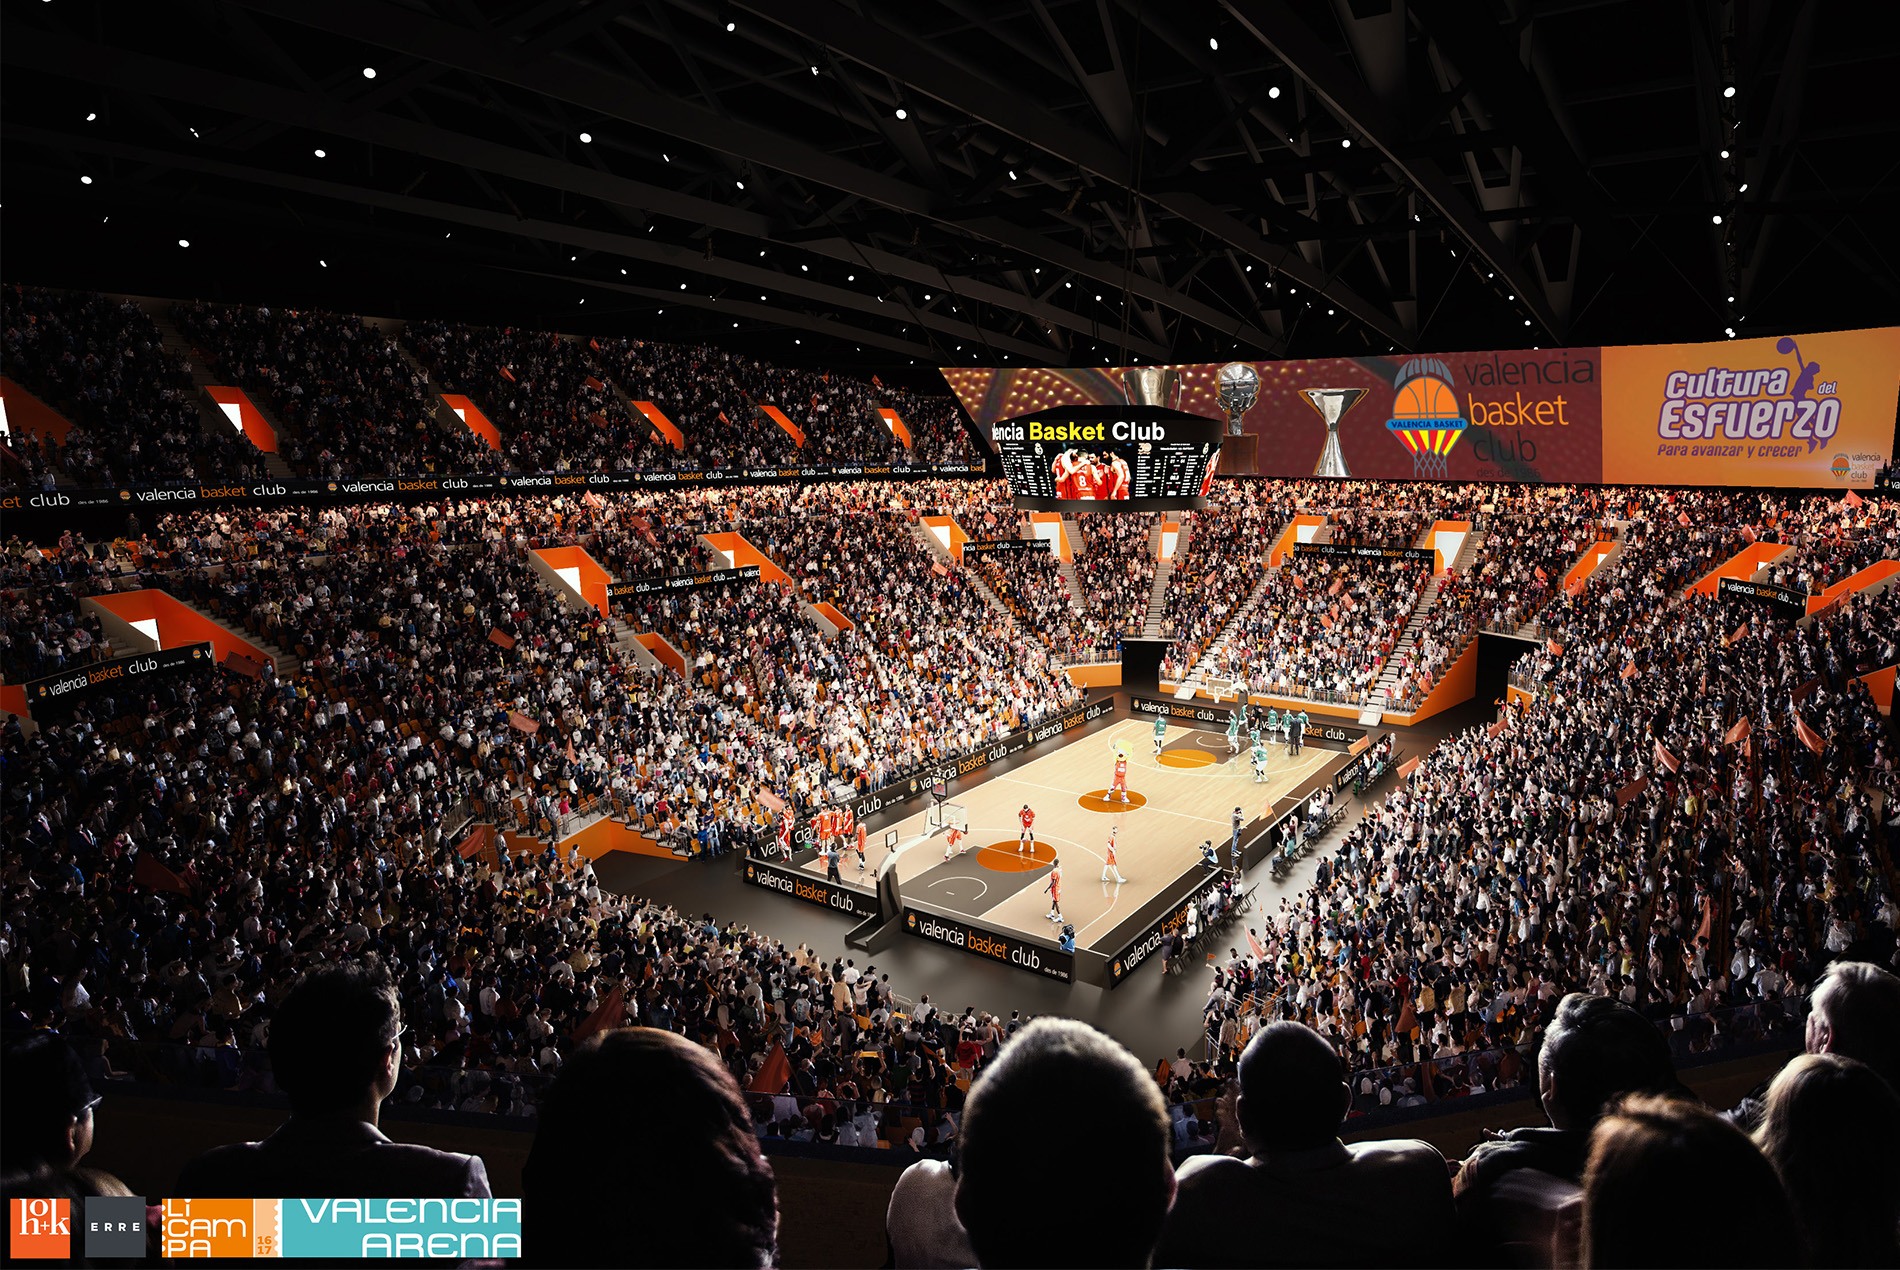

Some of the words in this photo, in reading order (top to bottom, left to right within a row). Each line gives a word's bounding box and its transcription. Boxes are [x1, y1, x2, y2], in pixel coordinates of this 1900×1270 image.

[1464, 352, 1594, 386] valencia
[1664, 367, 1791, 399] Cultura
[1817, 381, 1837, 395] del
[1468, 392, 1569, 426] basket
[1029, 421, 1105, 441] Basket
[1111, 421, 1165, 441] Club
[1391, 420, 1432, 429] VALENCIA
[1434, 420, 1463, 429] BASKET
[1473, 430, 1537, 462] club
[1657, 444, 1688, 456] Para
[1691, 445, 1743, 457] avanzar
[1748, 445, 1755, 458] y
[1758, 444, 1803, 457] crecer
[1851, 452, 1881, 461] valencia
[643, 472, 676, 481] valencia
[678, 471, 703, 480] basket
[706, 470, 723, 479] club
[750, 469, 777, 478] valencia
[778, 468, 800, 477] basket
[801, 468, 816, 476] club
[837, 466, 861, 475] valencia
[864, 465, 890, 474] basket
[892, 465, 911, 473] club
[939, 464, 969, 473] valencia
[1850, 470, 1868, 479] club
[342, 480, 394, 493] valencia
[398, 479, 438, 491] basket
[442, 478, 468, 489] club
[511, 476, 552, 487] valencia
[554, 475, 586, 485] basket
[589, 474, 610, 484] club
[1079, 475, 1087, 487] 8
[136, 487, 196, 501] valencia
[200, 485, 247, 498] basket
[253, 484, 286, 496] club
[30, 493, 70, 507] club
[977, 542, 995, 551] basket
[997, 541, 1010, 549] club
[1321, 546, 1335, 554] club
[1357, 548, 1381, 556] valencia
[1383, 549, 1403, 557] basket
[1405, 550, 1419, 558] club
[614, 585, 634, 595] basket
[636, 582, 650, 592] club
[671, 577, 694, 590] valencia
[694, 575, 712, 585] basket
[713, 573, 725, 582] club
[1727, 582, 1755, 594] valencia
[1756, 584, 1777, 598] basket
[49, 674, 88, 696] valencia
[89, 665, 124, 684] basket
[128, 658, 158, 674] club
[1140, 702, 1169, 714] valencia
[1171, 704, 1195, 718] basket
[1197, 710, 1214, 721] club
[1035, 721, 1063, 741] valencia
[1063, 711, 1085, 730] basket
[1086, 704, 1101, 720] club
[1305, 728, 1323, 737] sket
[1325, 728, 1345, 740] club
[958, 753, 987, 774] basket
[988, 744, 1007, 761] club
[857, 796, 882, 817] club
[757, 870, 793, 893] valencia
[795, 878, 827, 904] basket
[830, 891, 853, 911] club
[919, 920, 964, 946] valencia
[967, 931, 1007, 960] basket
[1011, 946, 1040, 969] club
[1123, 931, 1161, 970] valencia
